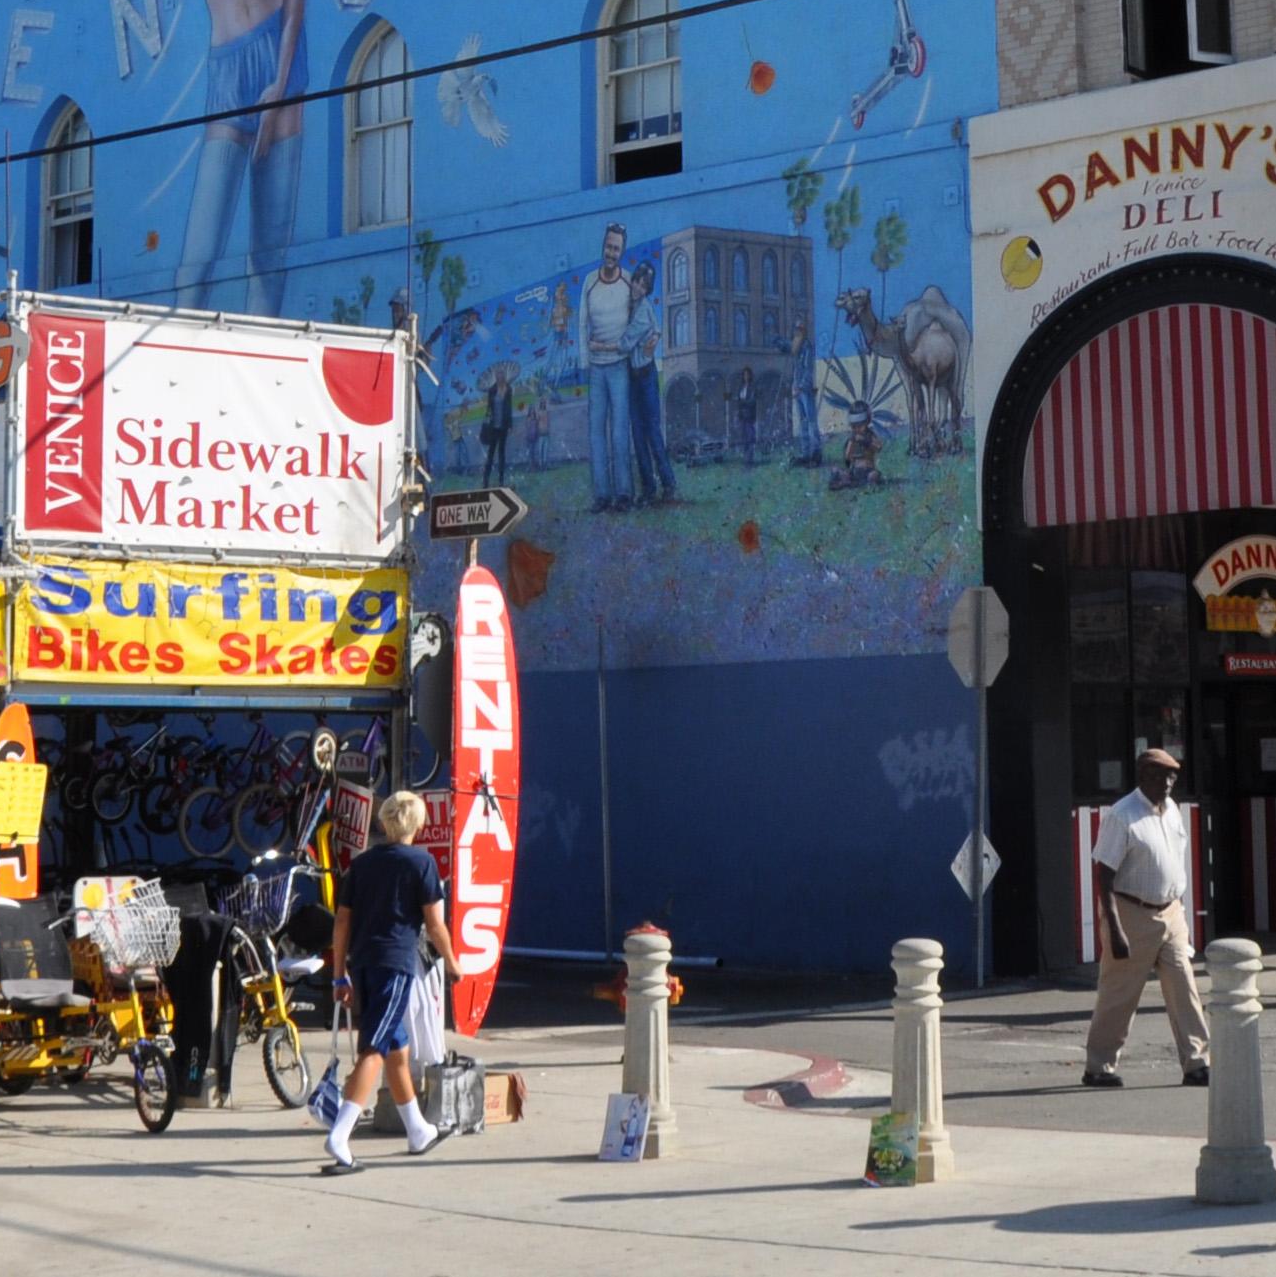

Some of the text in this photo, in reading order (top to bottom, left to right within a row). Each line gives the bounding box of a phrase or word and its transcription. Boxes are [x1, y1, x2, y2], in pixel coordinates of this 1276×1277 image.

[1122, 189, 1223, 231] DELI
[1142, 175, 1208, 196] Venice
[1030, 251, 1113, 329] Restaurant
[1122, 234, 1158, 263] Full
[1165, 229, 1199, 250] Bar
[1215, 229, 1266, 253] Food
[44, 329, 86, 516] VENICE
[114, 417, 369, 483] Sidewalk
[115, 477, 321, 537] Market
[439, 504, 492, 525] ONE WAY
[30, 565, 398, 636] Surfing
[26, 625, 399, 677] Bikes Skates
[339, 756, 365, 769] ATM
[457, 582, 514, 976] RENTALS
[338, 788, 370, 832] ATM
